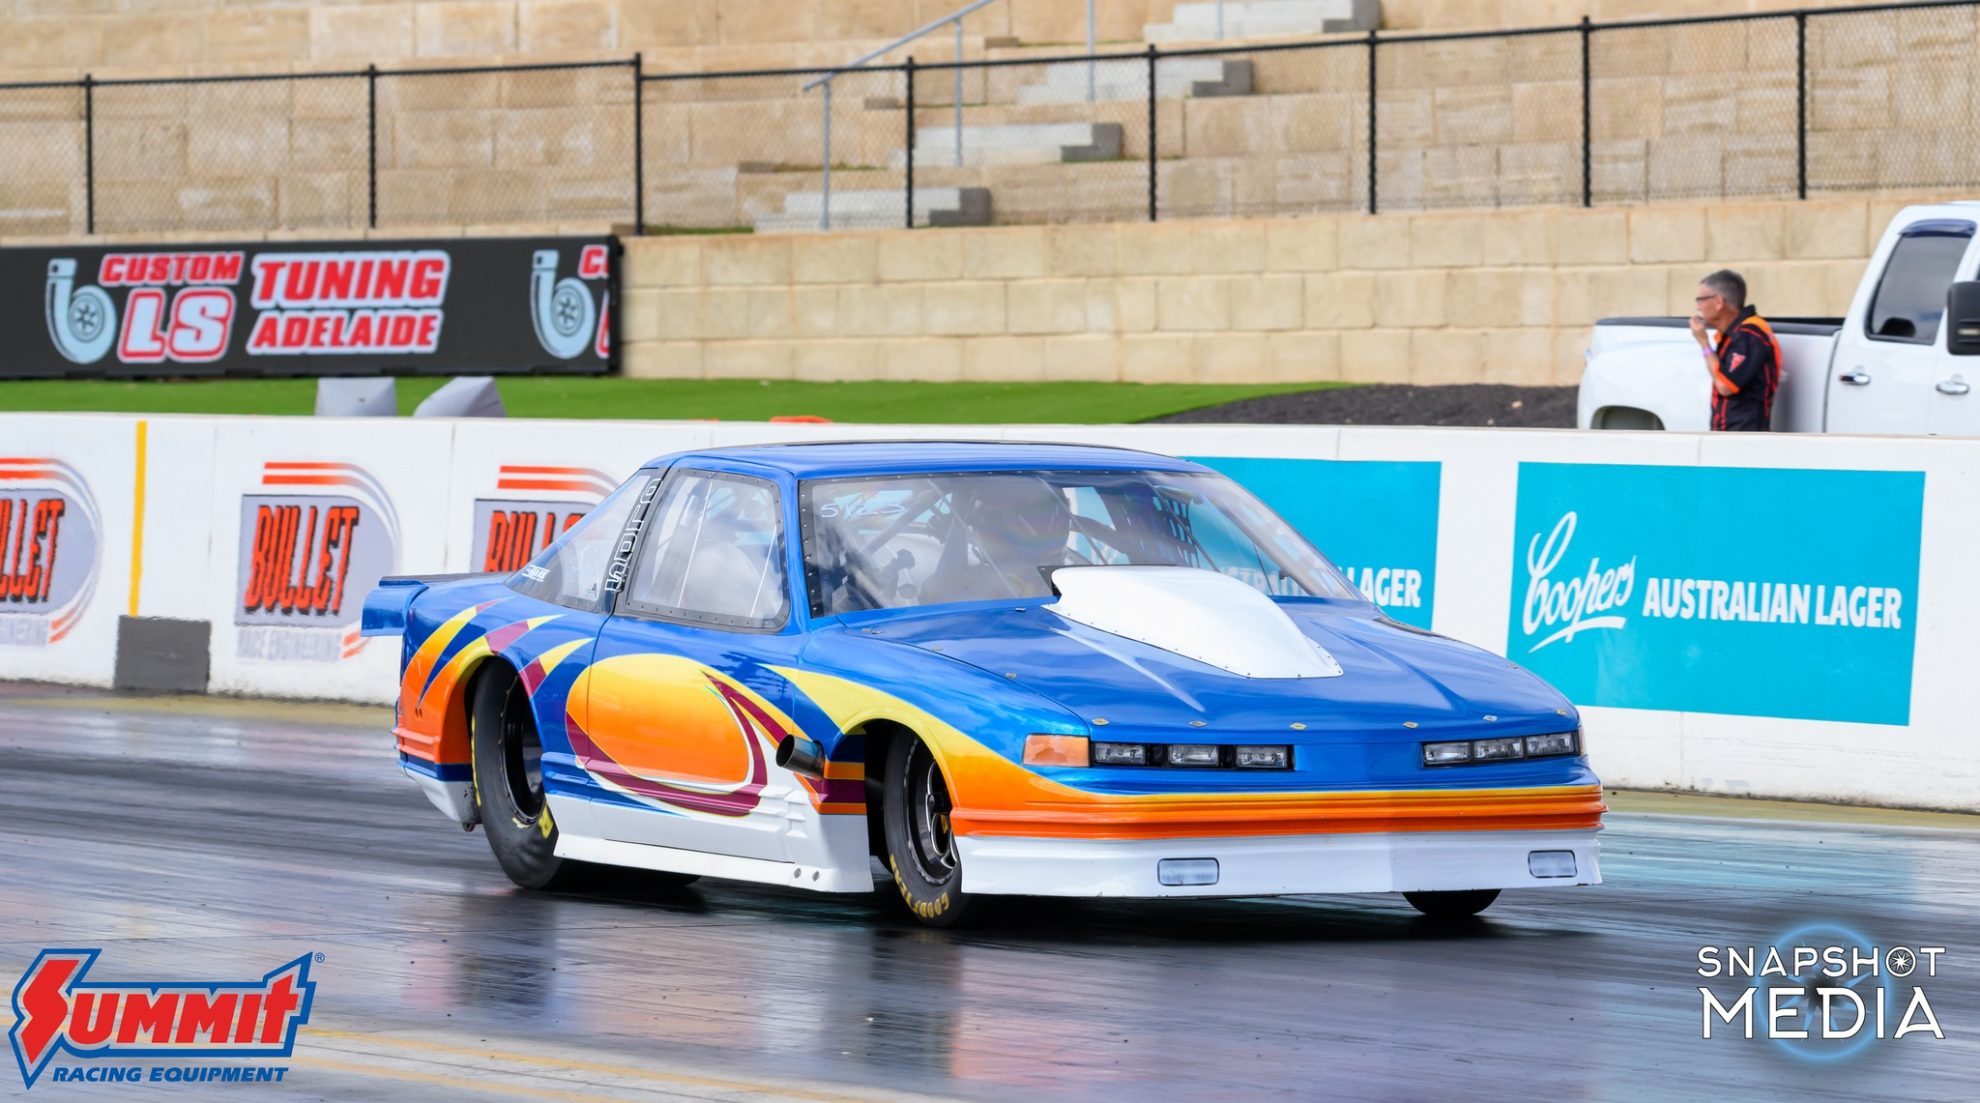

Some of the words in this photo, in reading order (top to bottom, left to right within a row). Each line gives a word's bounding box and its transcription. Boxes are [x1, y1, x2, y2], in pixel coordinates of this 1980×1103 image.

[101, 252, 244, 284] CUSTOM
[251, 251, 449, 309] TUNING
[118, 288, 236, 363] LS
[247, 310, 443, 355] ADELAIDE
[244, 505, 360, 615] BULLET
[1522, 511, 1637, 644] Coopers
[1642, 577, 1809, 625] AUSTRALIAN
[1815, 585, 1902, 629] LAGER
